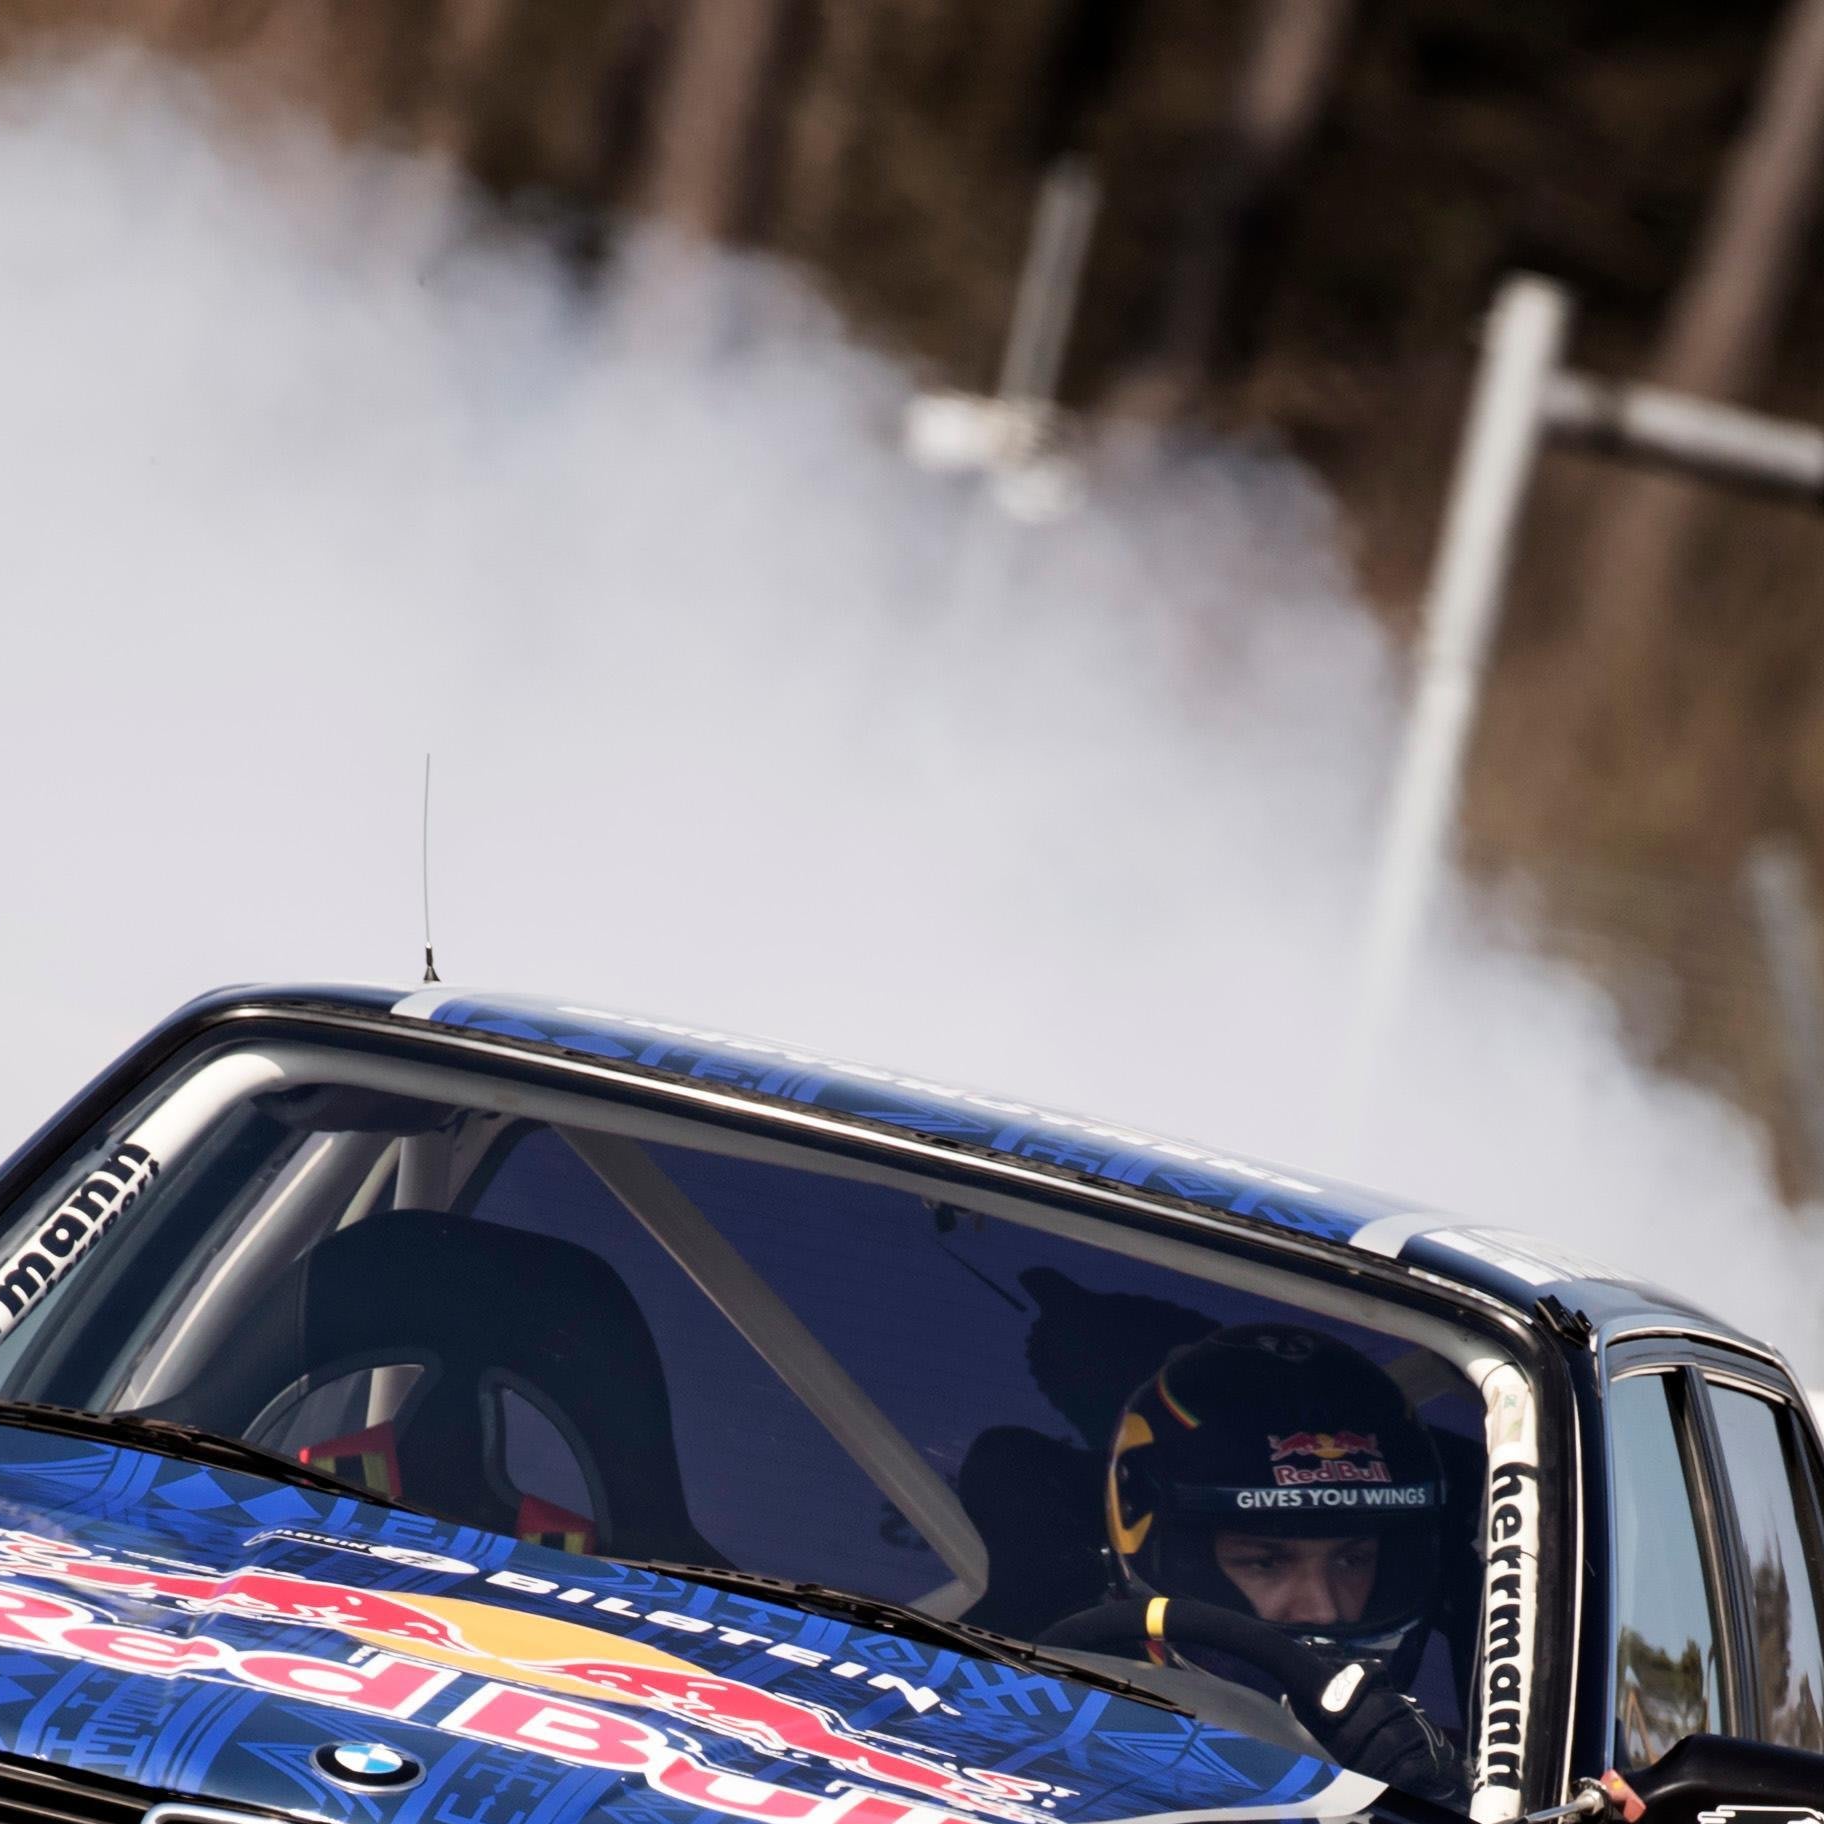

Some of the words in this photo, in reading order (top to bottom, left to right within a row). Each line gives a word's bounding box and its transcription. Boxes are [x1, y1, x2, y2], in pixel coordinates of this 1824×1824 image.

[1237, 1489, 1302, 1508] GIVES
[1307, 1488, 1358, 1506] YOU
[1362, 1487, 1426, 1505] WINGS
[1273, 1460, 1333, 1486] Red
[1333, 1461, 1392, 1483] Bull
[485, 1570, 940, 1714] BILSTEIN
[1487, 1461, 1538, 1790] herrmann
